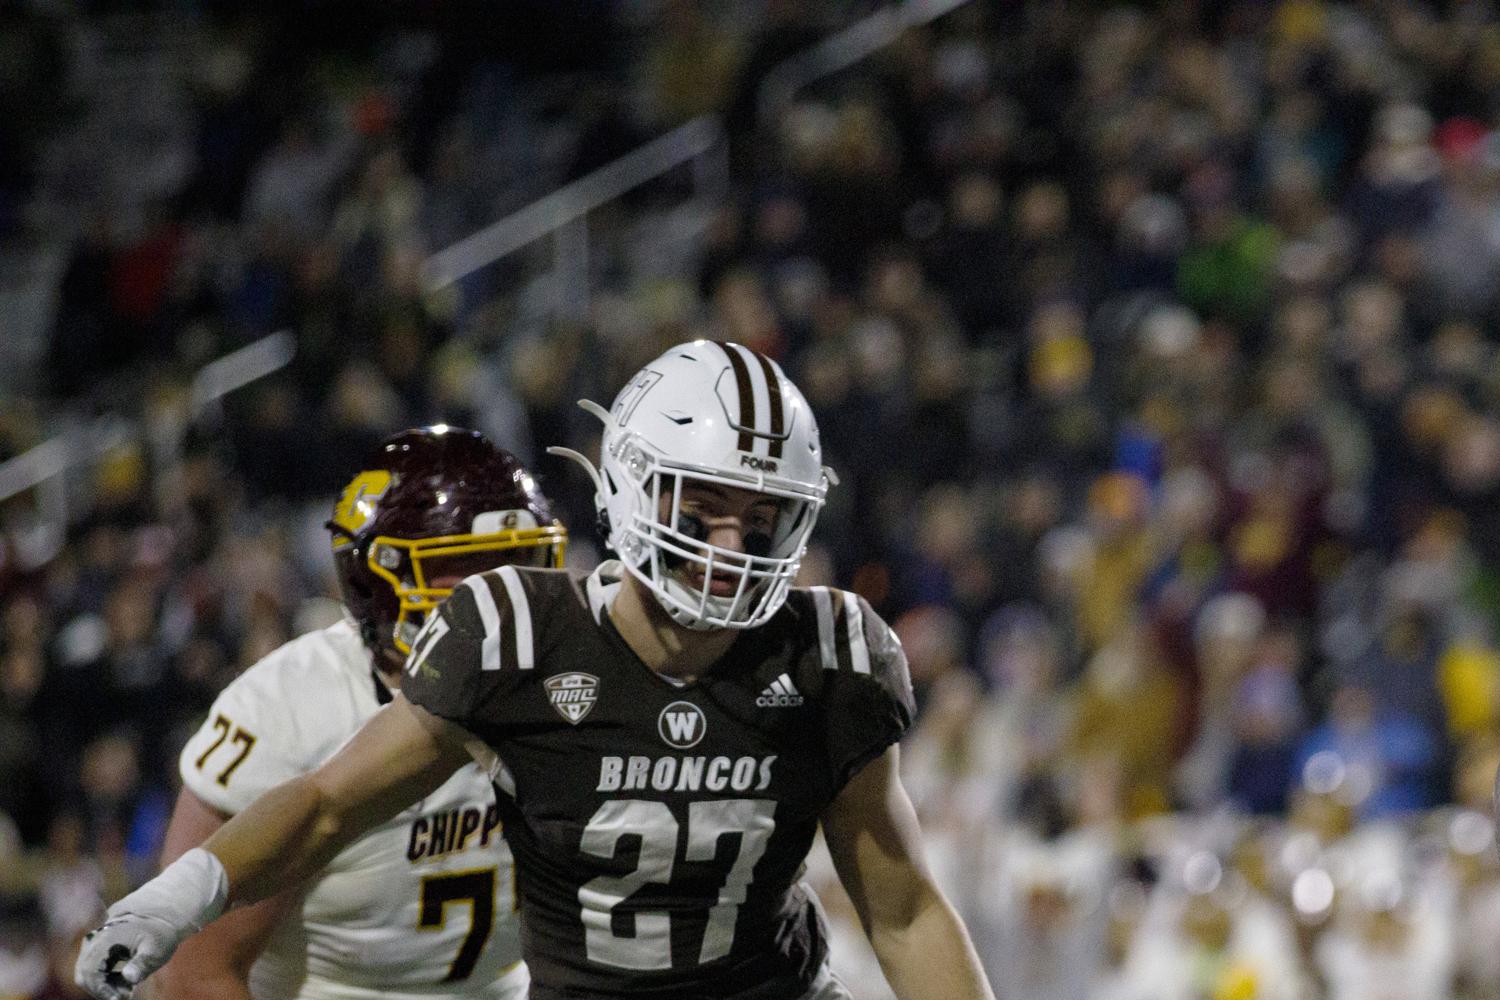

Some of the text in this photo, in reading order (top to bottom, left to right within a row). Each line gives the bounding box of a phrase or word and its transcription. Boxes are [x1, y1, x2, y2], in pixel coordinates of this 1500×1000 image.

[550, 687, 598, 704] MAC
[755, 695, 804, 708] adidas
[665, 711, 699, 741] W
[195, 713, 257, 788] 77
[595, 755, 779, 792] BRONCOS
[578, 799, 779, 971] 27
[416, 862, 522, 982] 7
